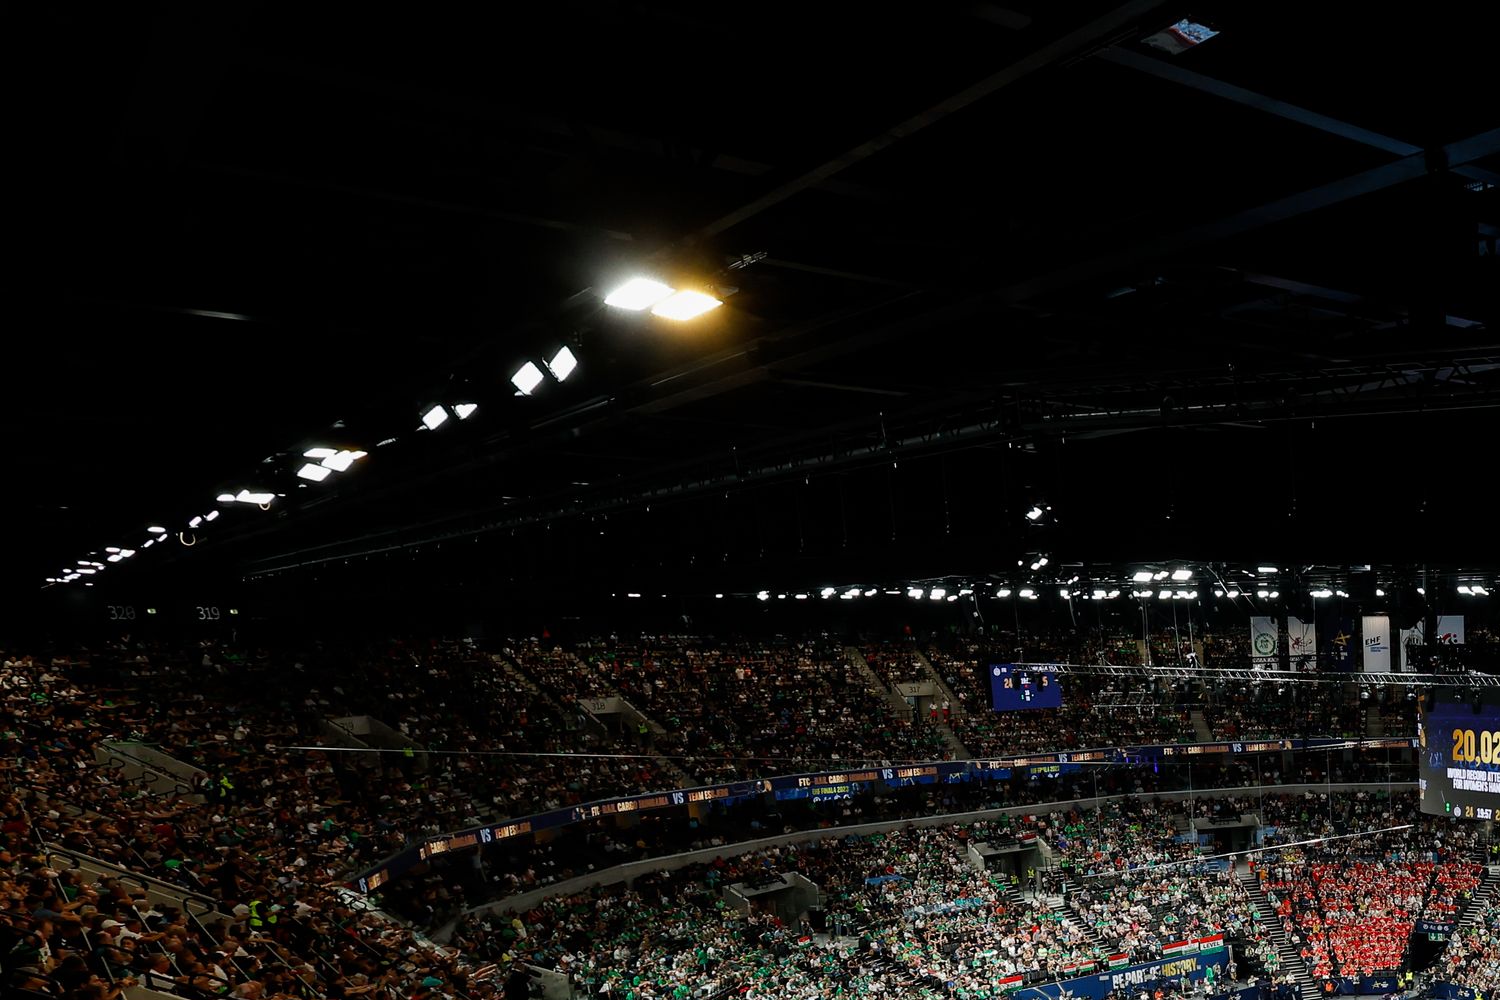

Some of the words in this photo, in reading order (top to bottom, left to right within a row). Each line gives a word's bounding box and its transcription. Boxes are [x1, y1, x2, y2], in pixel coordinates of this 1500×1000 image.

[107, 605, 136, 620] 320
[196, 606, 220, 620] 319
[1365, 634, 1382, 645] EHF
[1233, 743, 1242, 752] VS
[882, 769, 893, 780] VS
[897, 768, 914, 777] TEAM
[1447, 768, 1466, 779] WORLD
[1466, 769, 1487, 781] RECORD
[1453, 778, 1463, 789] FOR
[672, 792, 684, 804] VS
[1465, 806, 1474, 817] 24
[1203, 941, 1220, 949] LEVEL
[1161, 958, 1197, 978] HISTORY
